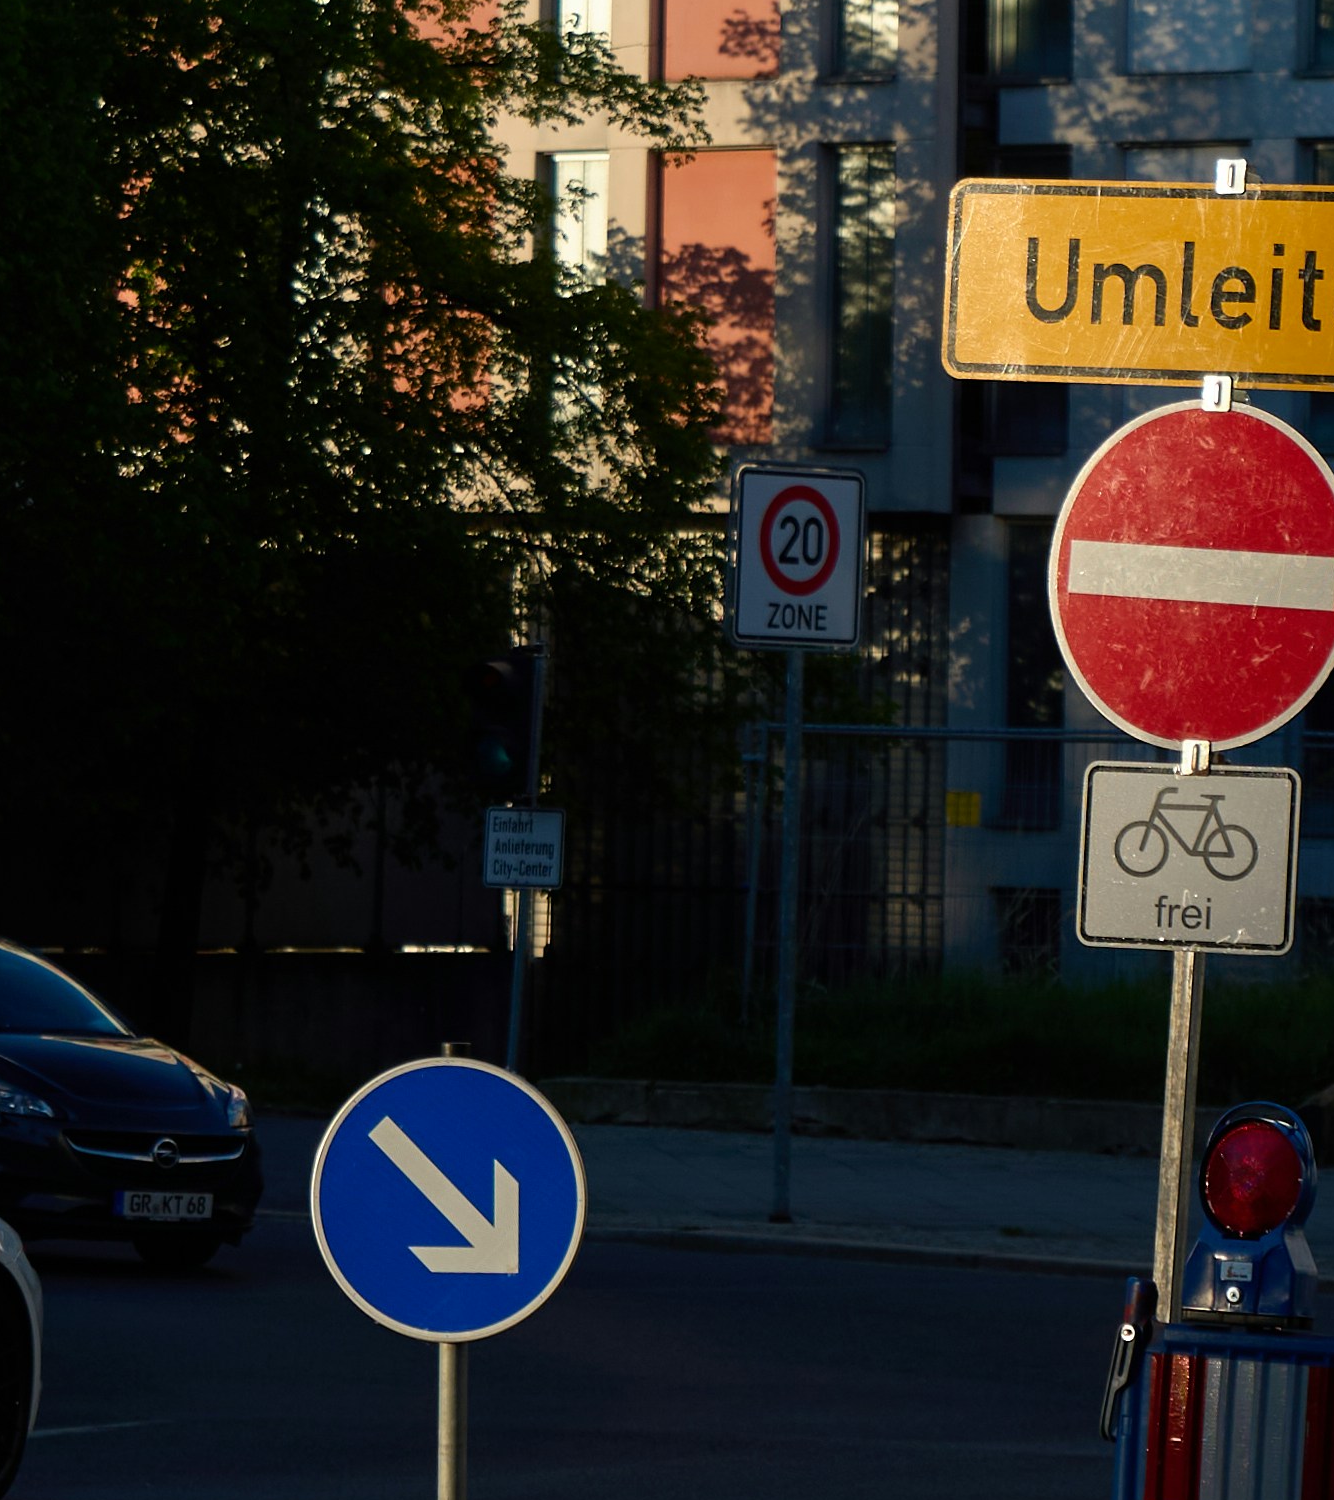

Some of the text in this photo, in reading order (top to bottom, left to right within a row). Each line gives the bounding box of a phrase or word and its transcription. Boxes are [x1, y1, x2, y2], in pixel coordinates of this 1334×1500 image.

[778, 515, 824, 567] 20
[767, 602, 828, 632] ZONE
[492, 815, 534, 833] Einfahrt
[495, 839, 555, 860] Anlieferung
[492, 859, 554, 879] City-Center
[1154, 895, 1212, 930] frei
[130, 1194, 207, 1215] GR KT 68
